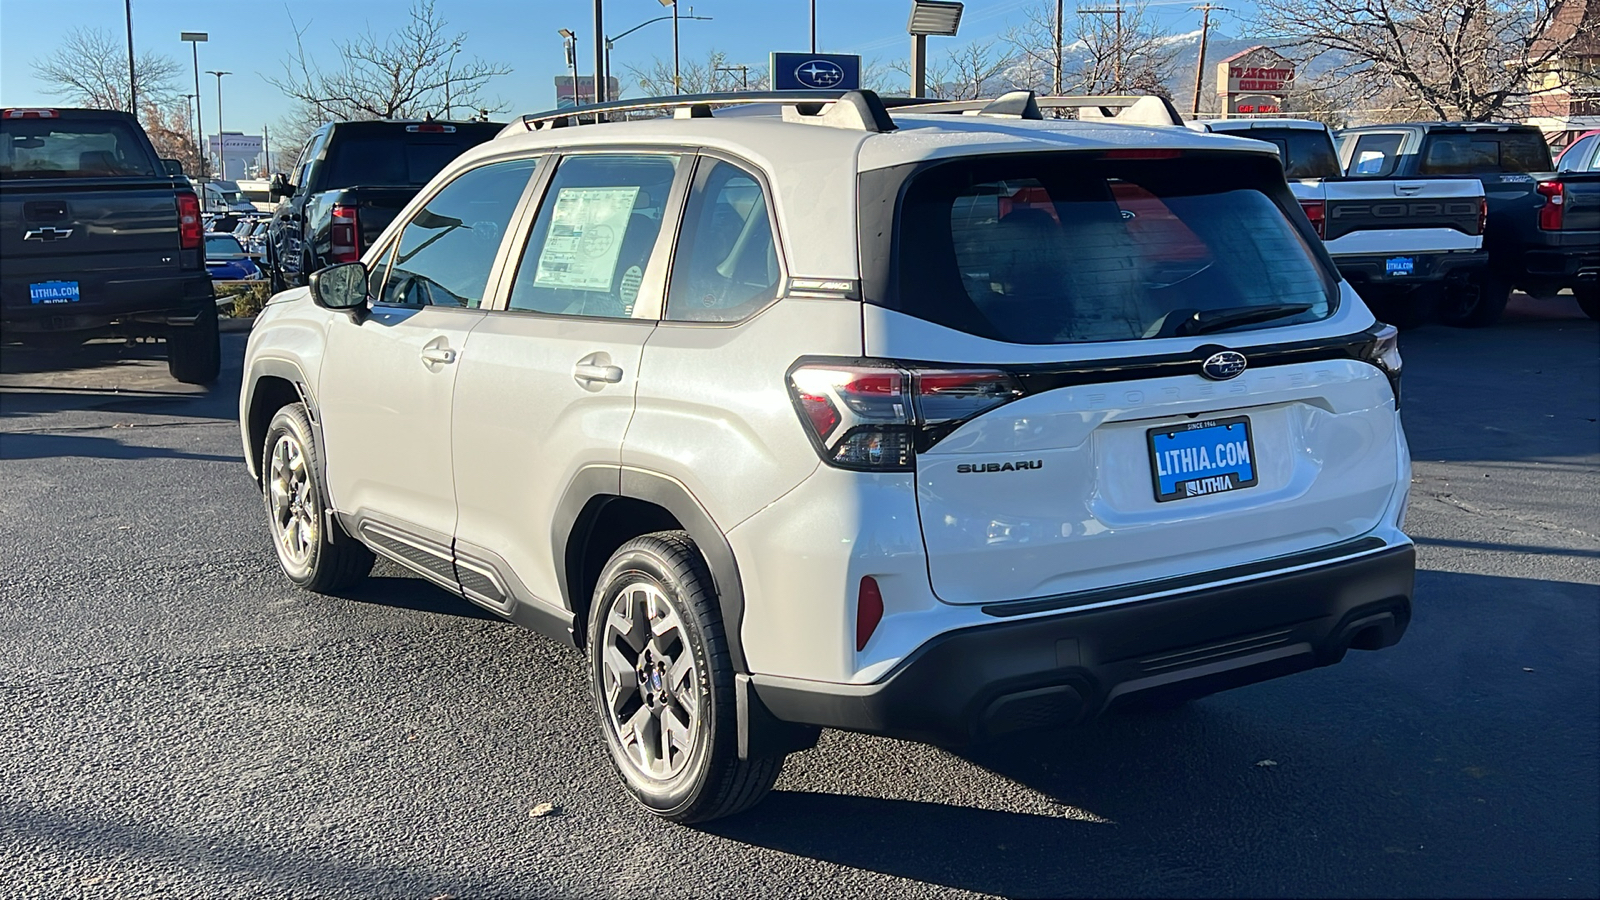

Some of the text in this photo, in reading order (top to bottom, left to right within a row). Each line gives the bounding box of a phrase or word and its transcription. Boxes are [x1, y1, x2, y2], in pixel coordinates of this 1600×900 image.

[1332, 203, 1476, 218] FORD
[1386, 262, 1414, 270] LITHIA.COM
[31, 286, 79, 298] LITHIA.COM
[1086, 370, 1330, 408] FORESTER
[1187, 422, 1203, 430] SINCE
[1156, 440, 1250, 477] LITHIA.COM
[957, 460, 1043, 473] SUBARU
[1196, 475, 1233, 495] LITHIA
